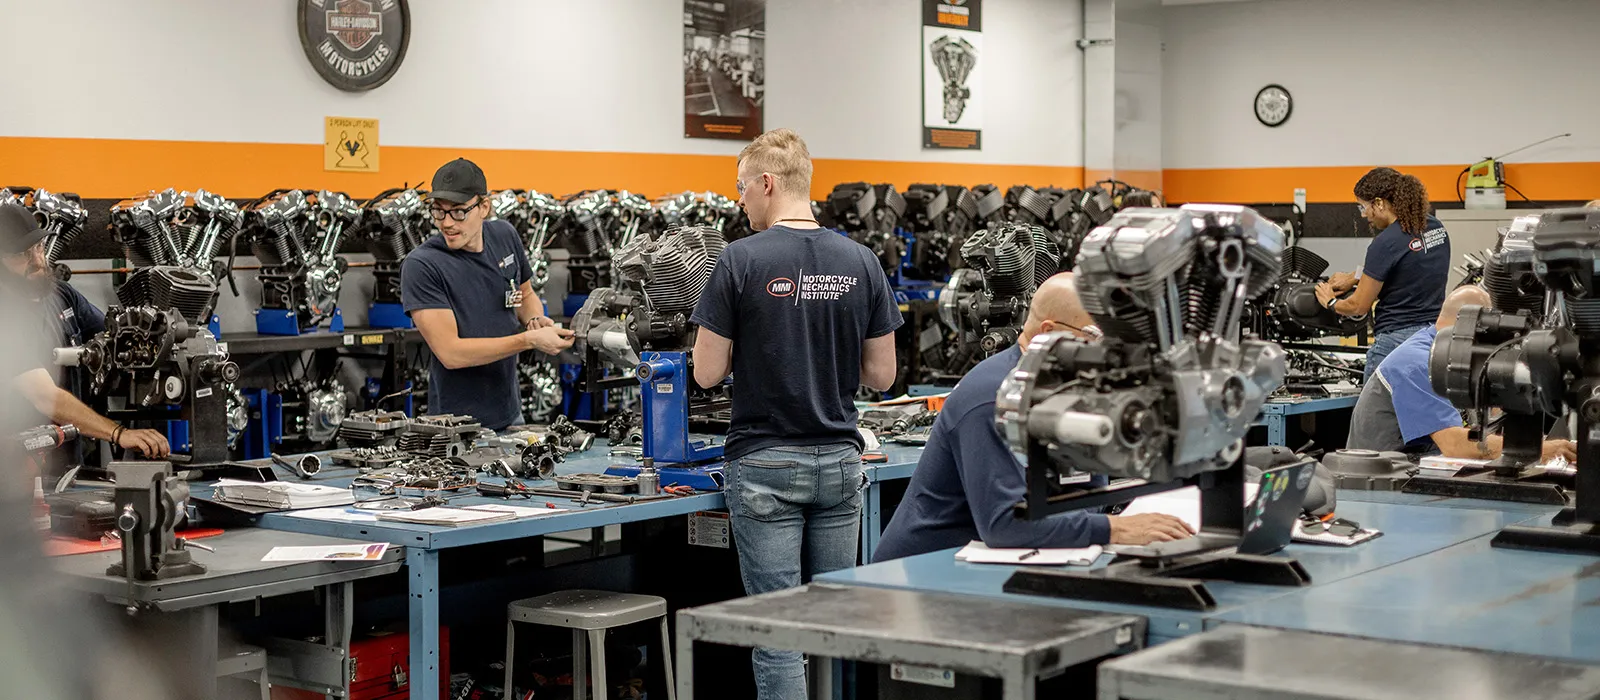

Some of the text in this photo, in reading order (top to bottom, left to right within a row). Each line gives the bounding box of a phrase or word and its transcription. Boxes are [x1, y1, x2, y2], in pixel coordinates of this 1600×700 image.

[320, 41, 389, 76] MOTORCYCLES
[803, 275, 858, 286] MOTORCYCLE
[772, 283, 791, 292] MMI
[802, 283, 850, 293] MECHANICS
